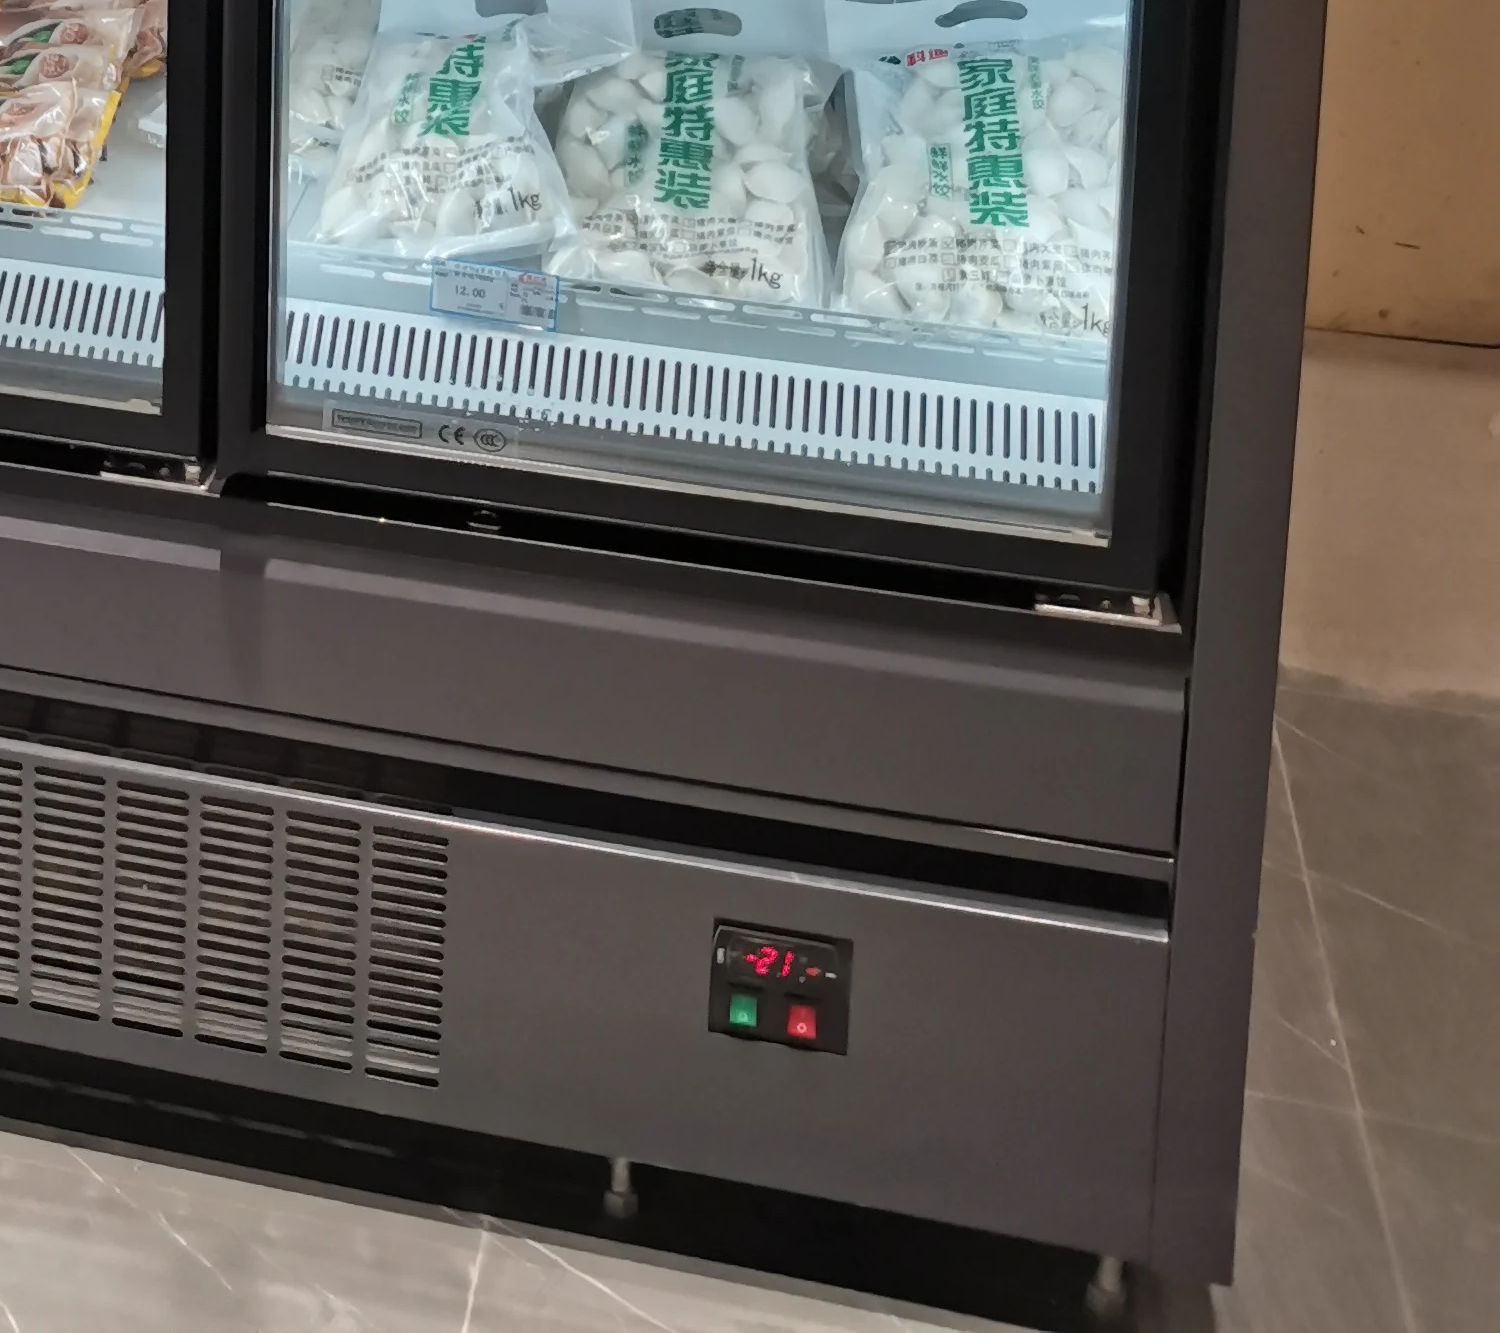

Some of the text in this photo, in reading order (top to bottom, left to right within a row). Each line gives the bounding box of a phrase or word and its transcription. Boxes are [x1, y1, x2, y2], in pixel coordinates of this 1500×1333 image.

[956, 57, 1030, 228] 家庭特惠装
[510, 186, 543, 213] 1kg
[750, 256, 783, 290] 1kg
[454, 284, 486, 300] 12.00
